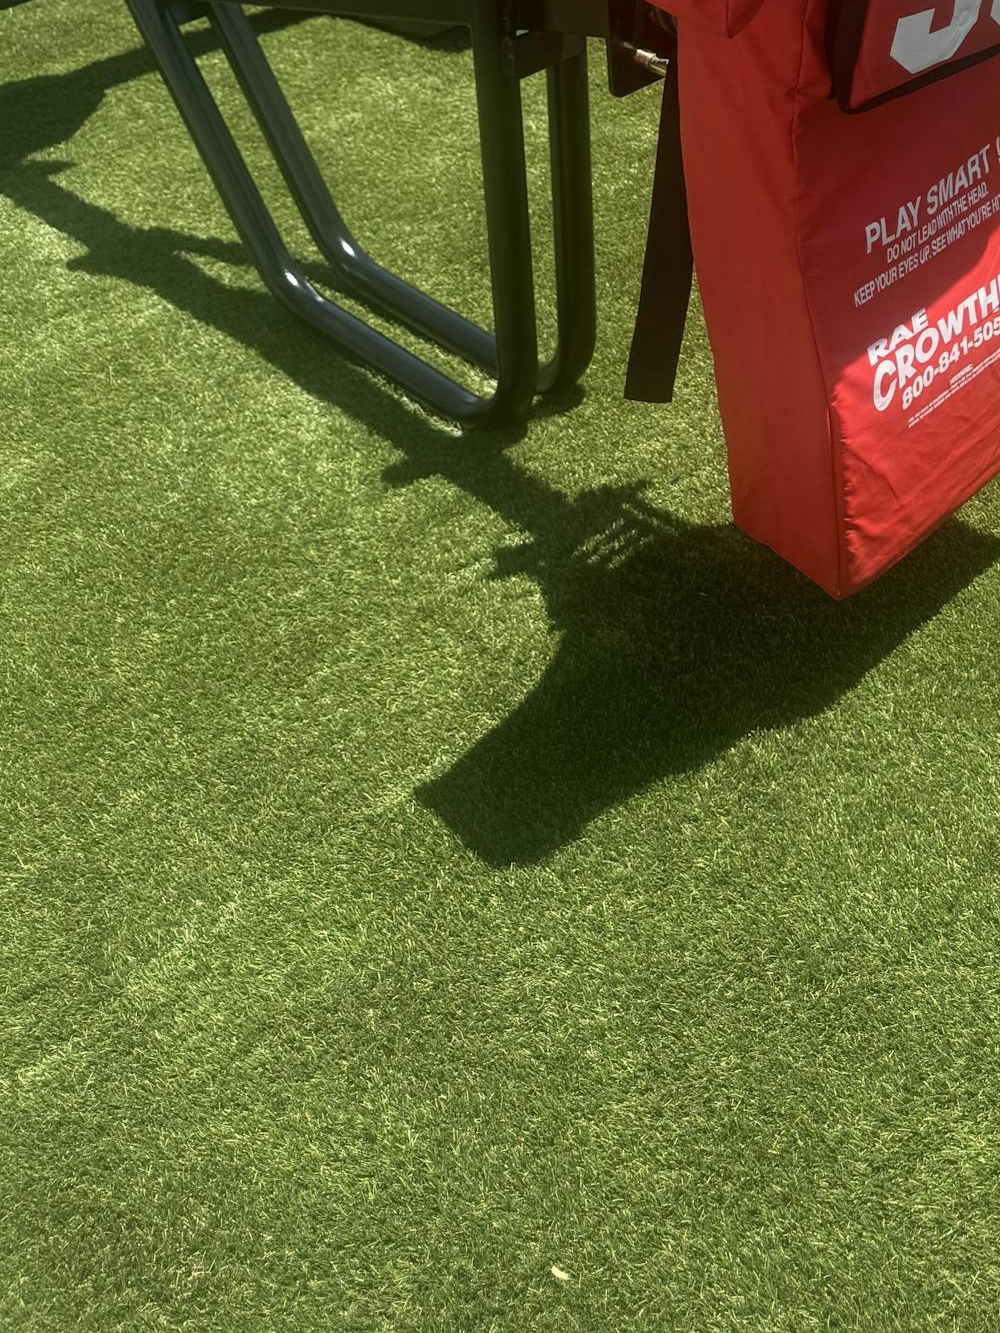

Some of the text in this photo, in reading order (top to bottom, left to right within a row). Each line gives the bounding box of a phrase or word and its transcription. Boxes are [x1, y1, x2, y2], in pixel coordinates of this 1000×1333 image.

[864, 195, 922, 254] PLAY
[926, 143, 991, 215] SMART
[886, 181, 989, 263] DO NOT LEAD WITH THE HEAD.
[853, 280, 876, 308] KEEP
[874, 267, 898, 294] YOUR
[898, 252, 919, 279] EYES
[931, 233, 947, 256] SEE
[945, 218, 967, 246] WHAT
[867, 307, 930, 366] RAE
